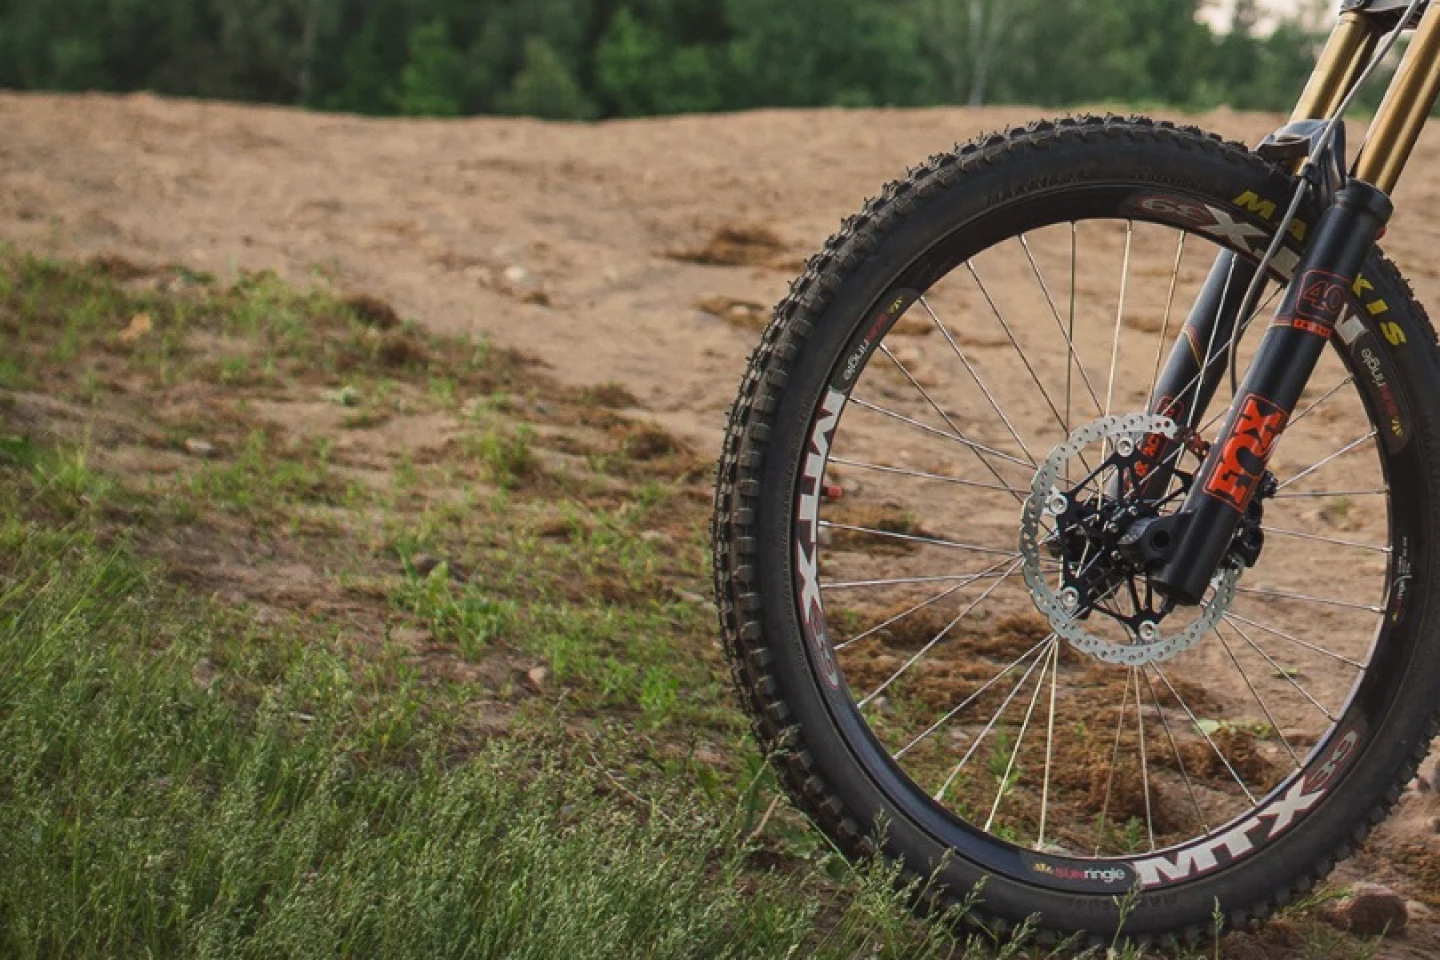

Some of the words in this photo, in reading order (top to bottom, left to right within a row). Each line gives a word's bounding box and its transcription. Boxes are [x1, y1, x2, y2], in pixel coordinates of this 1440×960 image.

[1302, 279, 1345, 315] 40
[797, 386, 846, 625] MTX
[1208, 398, 1282, 505] FOX
[1133, 774, 1325, 886] MTX
